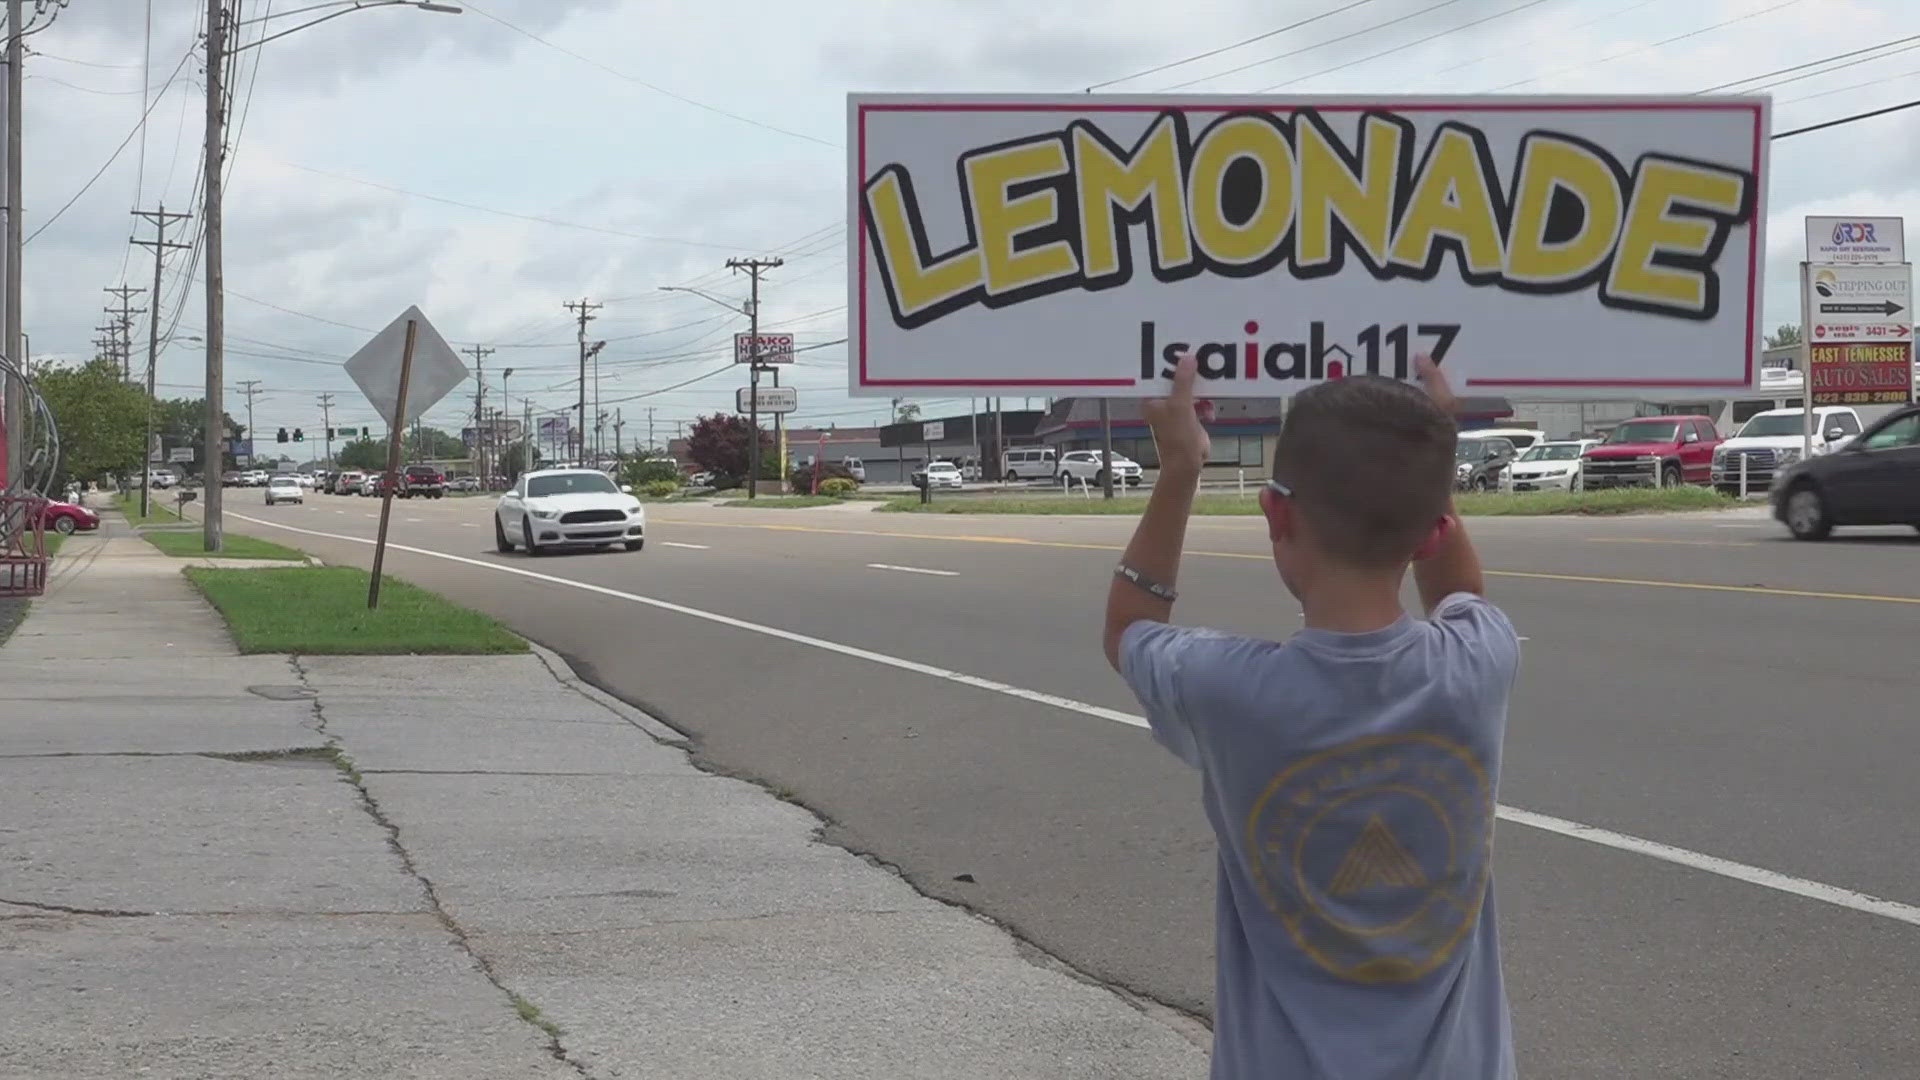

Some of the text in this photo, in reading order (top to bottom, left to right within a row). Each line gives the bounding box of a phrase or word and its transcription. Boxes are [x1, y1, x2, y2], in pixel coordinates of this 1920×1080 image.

[865, 107, 1754, 331] LEMONADE
[1832, 280, 1907, 291] STEPPING OUT
[1812, 347, 1906, 362] EAST TENNESSEE
[1813, 367, 1907, 387] AUTO SALES
